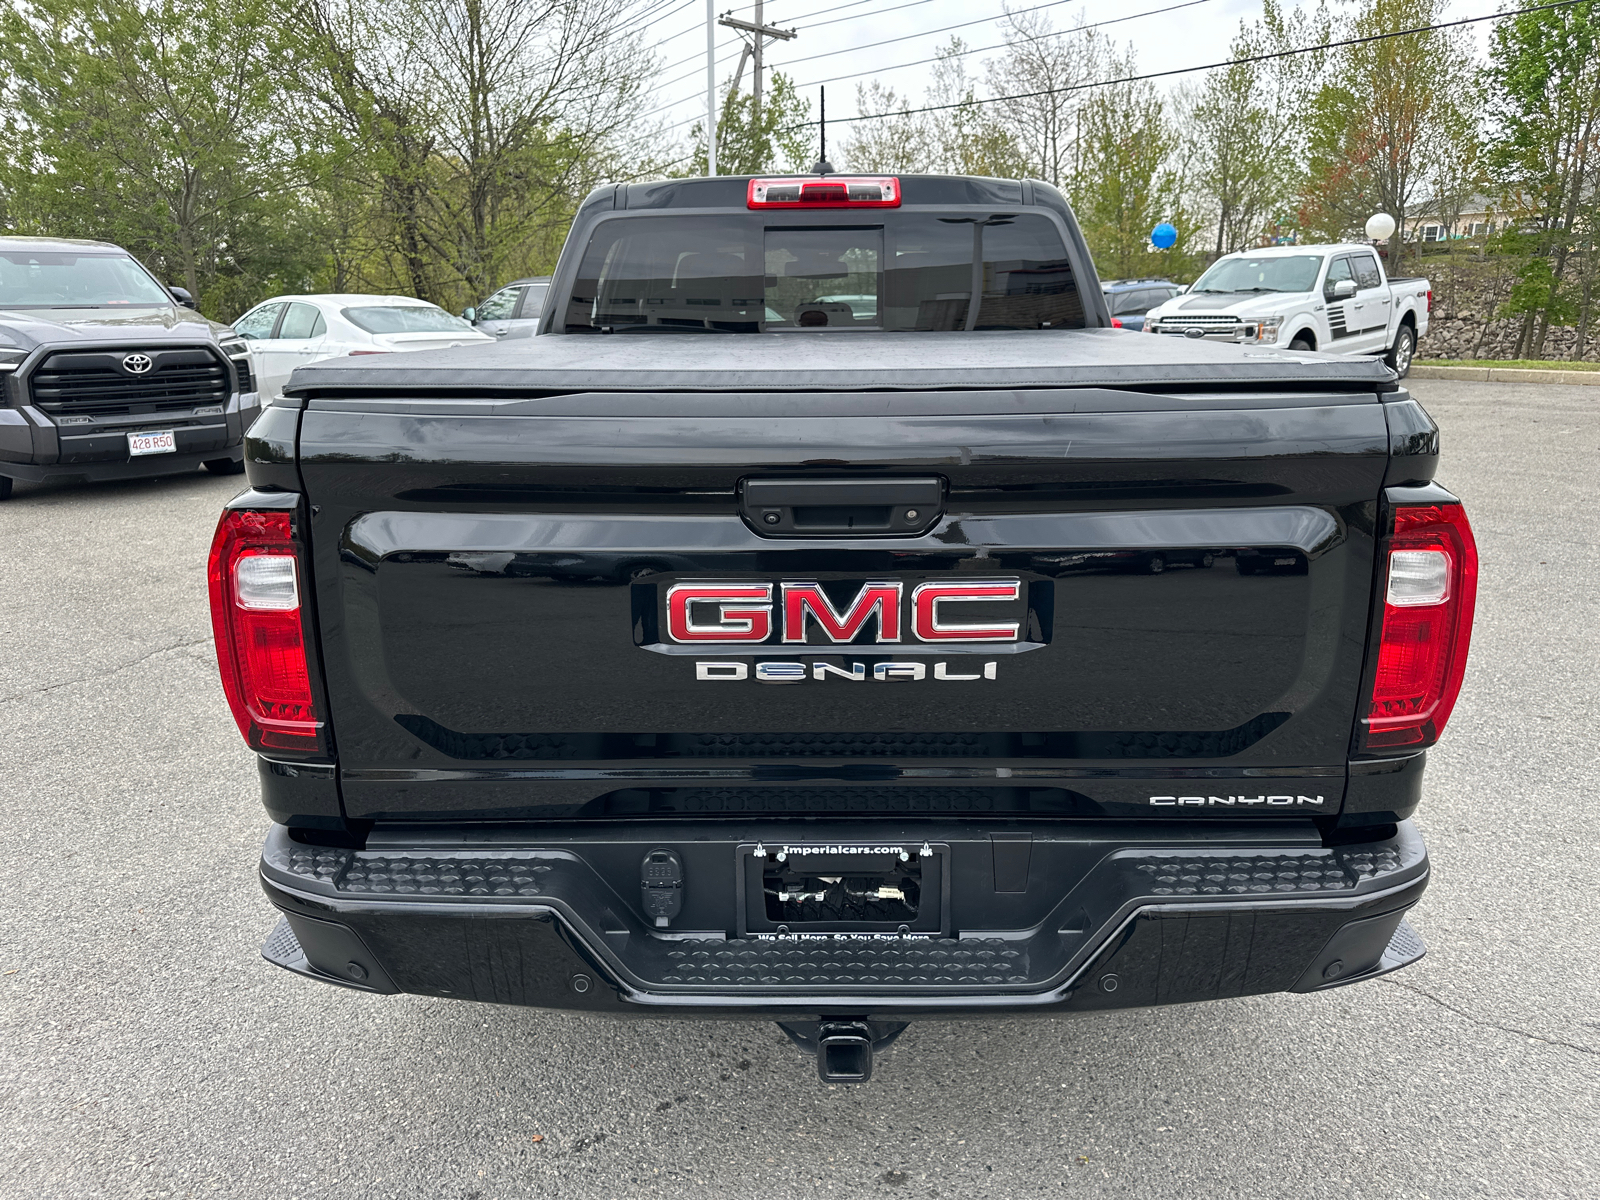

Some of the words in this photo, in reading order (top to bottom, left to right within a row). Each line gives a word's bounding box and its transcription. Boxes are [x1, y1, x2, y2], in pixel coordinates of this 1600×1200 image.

[132, 437, 152, 450] 428
[152, 435, 173, 448] R50
[666, 580, 1021, 644] GMC
[695, 661, 997, 681] DENALI
[1149, 795, 1324, 806] CANYON
[782, 845, 903, 856] Imperialcars.com
